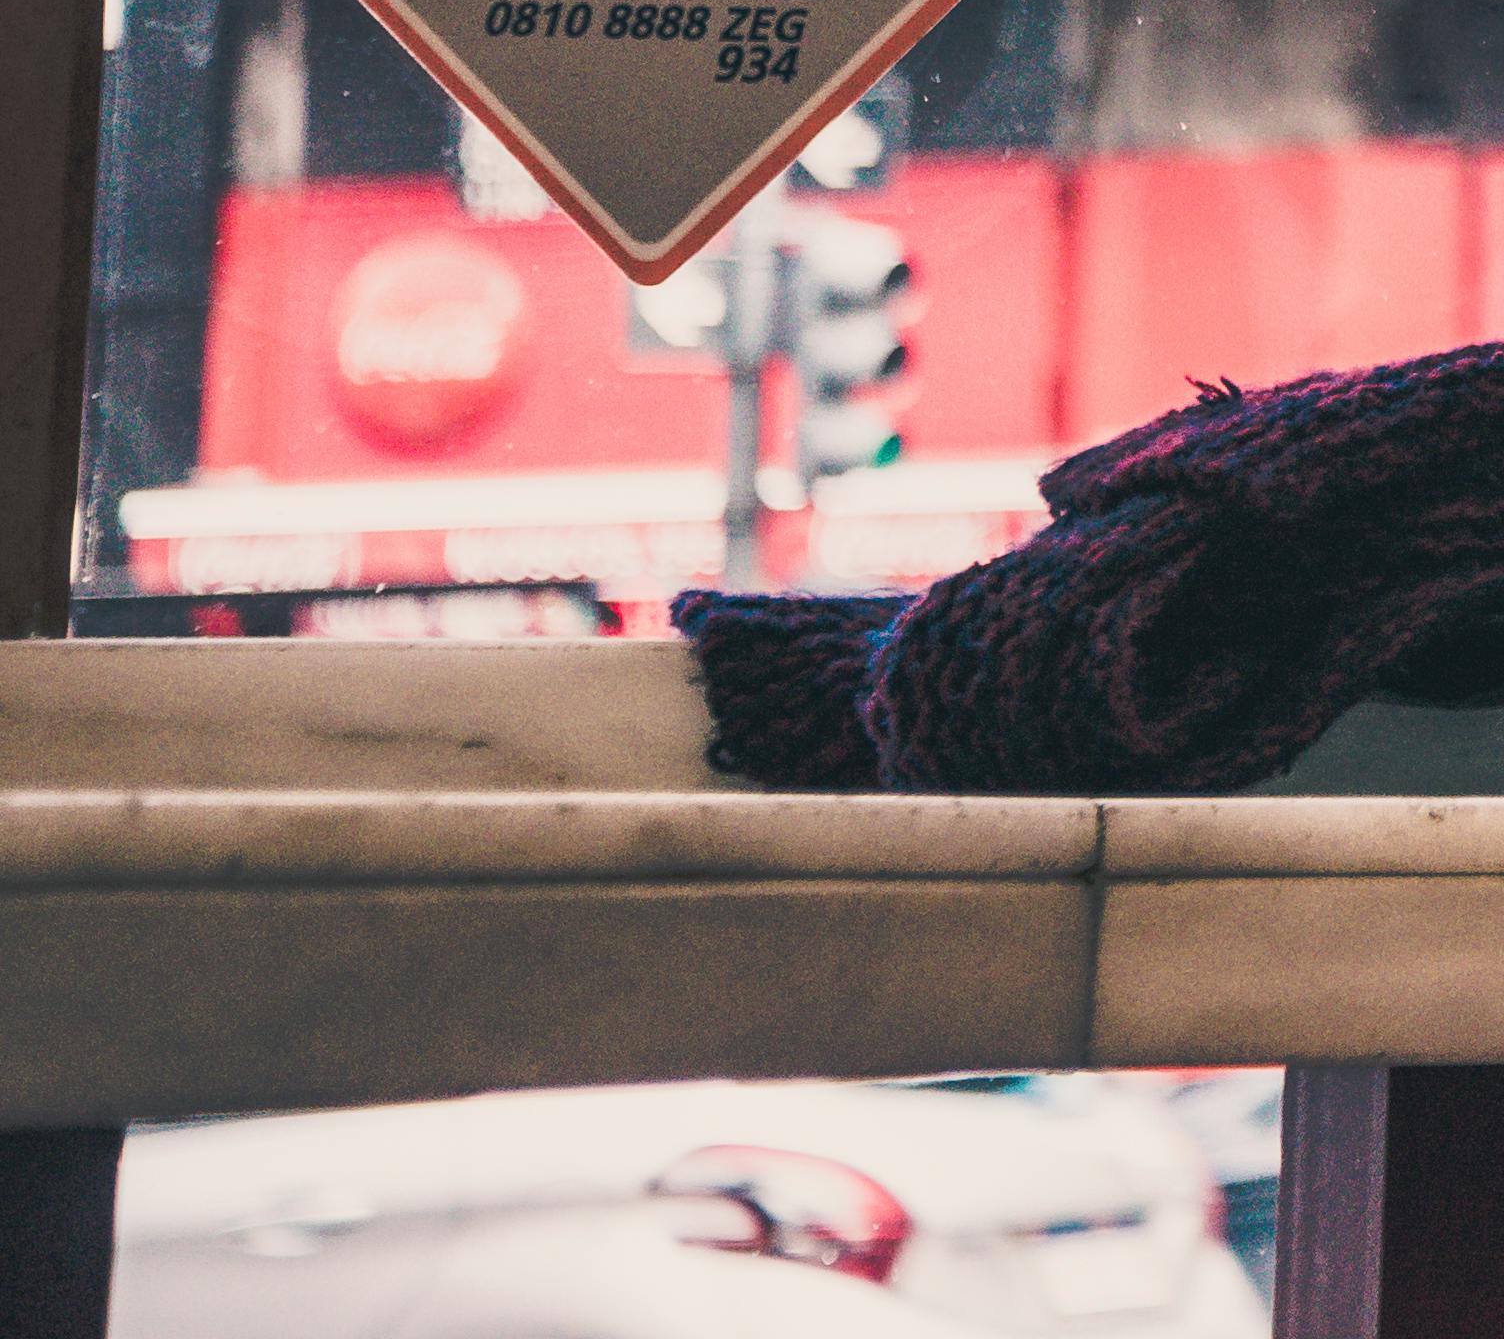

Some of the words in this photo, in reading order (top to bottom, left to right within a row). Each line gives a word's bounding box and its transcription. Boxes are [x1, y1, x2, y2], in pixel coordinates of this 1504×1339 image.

[601, 1, 713, 43] 8888
[717, 6, 811, 44] ZEG
[712, 42, 801, 85] 934
